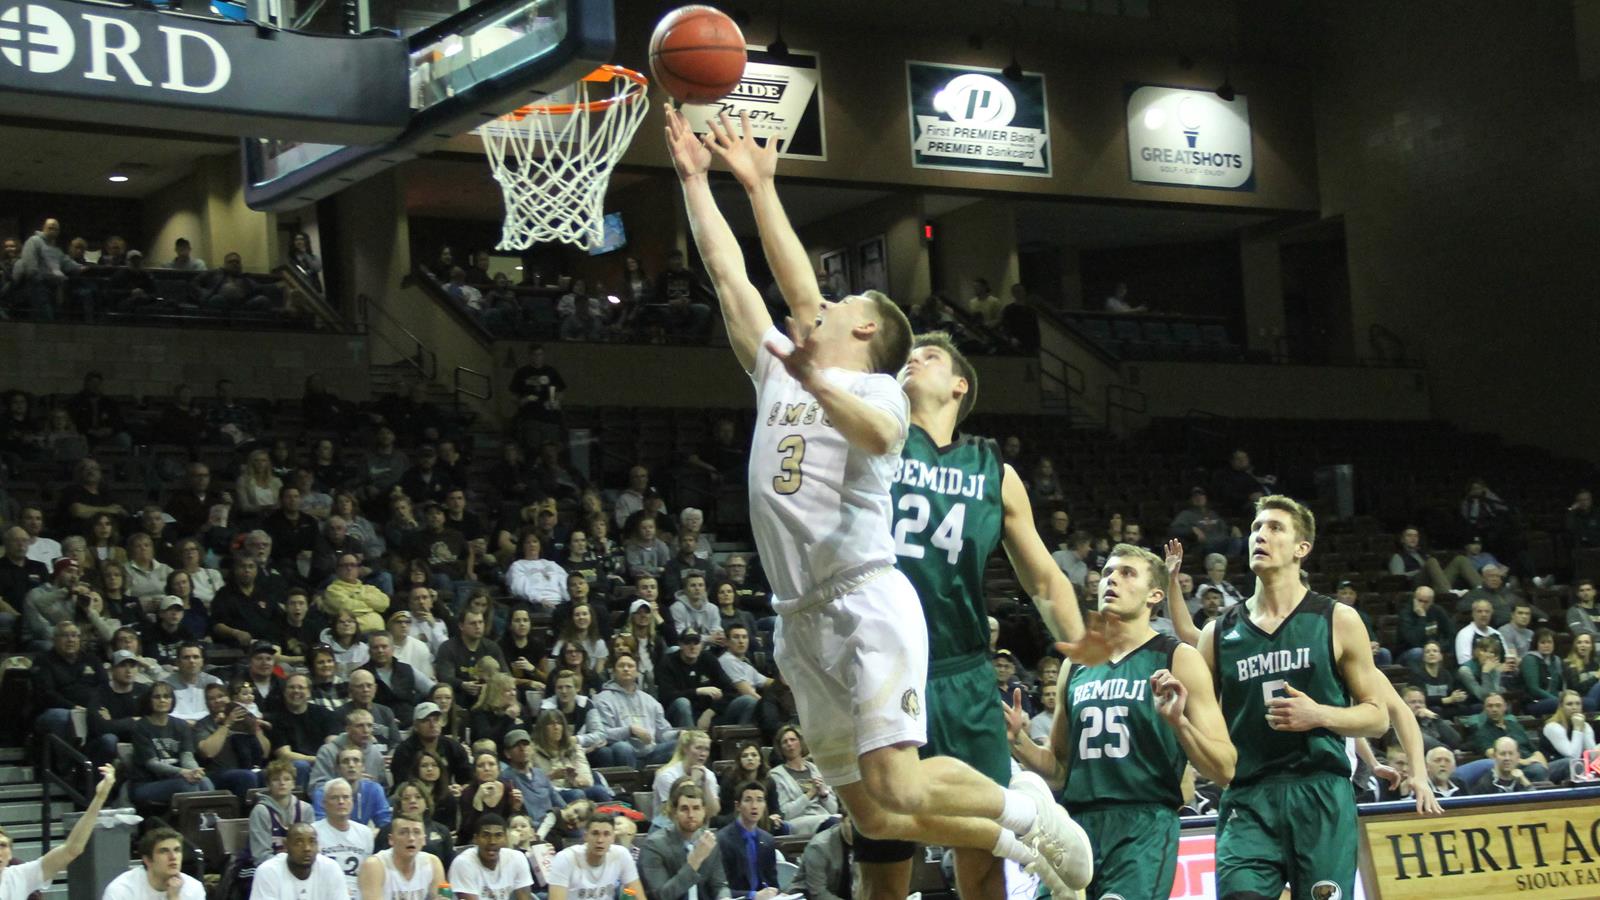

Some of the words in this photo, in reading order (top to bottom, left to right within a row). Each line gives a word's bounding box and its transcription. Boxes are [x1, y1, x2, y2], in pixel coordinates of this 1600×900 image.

[927, 124, 951, 137] First
[953, 127, 1008, 141] PREMIER
[1011, 131, 1035, 143] Bank
[928, 141, 982, 155] PREMIER
[986, 147, 1035, 160] Bankcard
[773, 434, 806, 495] 3
[895, 494, 966, 565] 24
[1236, 648, 1311, 682] BEMIDJI
[1073, 679, 1147, 706] BEMIDJI
[1079, 705, 1130, 760] 25
[1515, 871, 1571, 891] SIOUX
